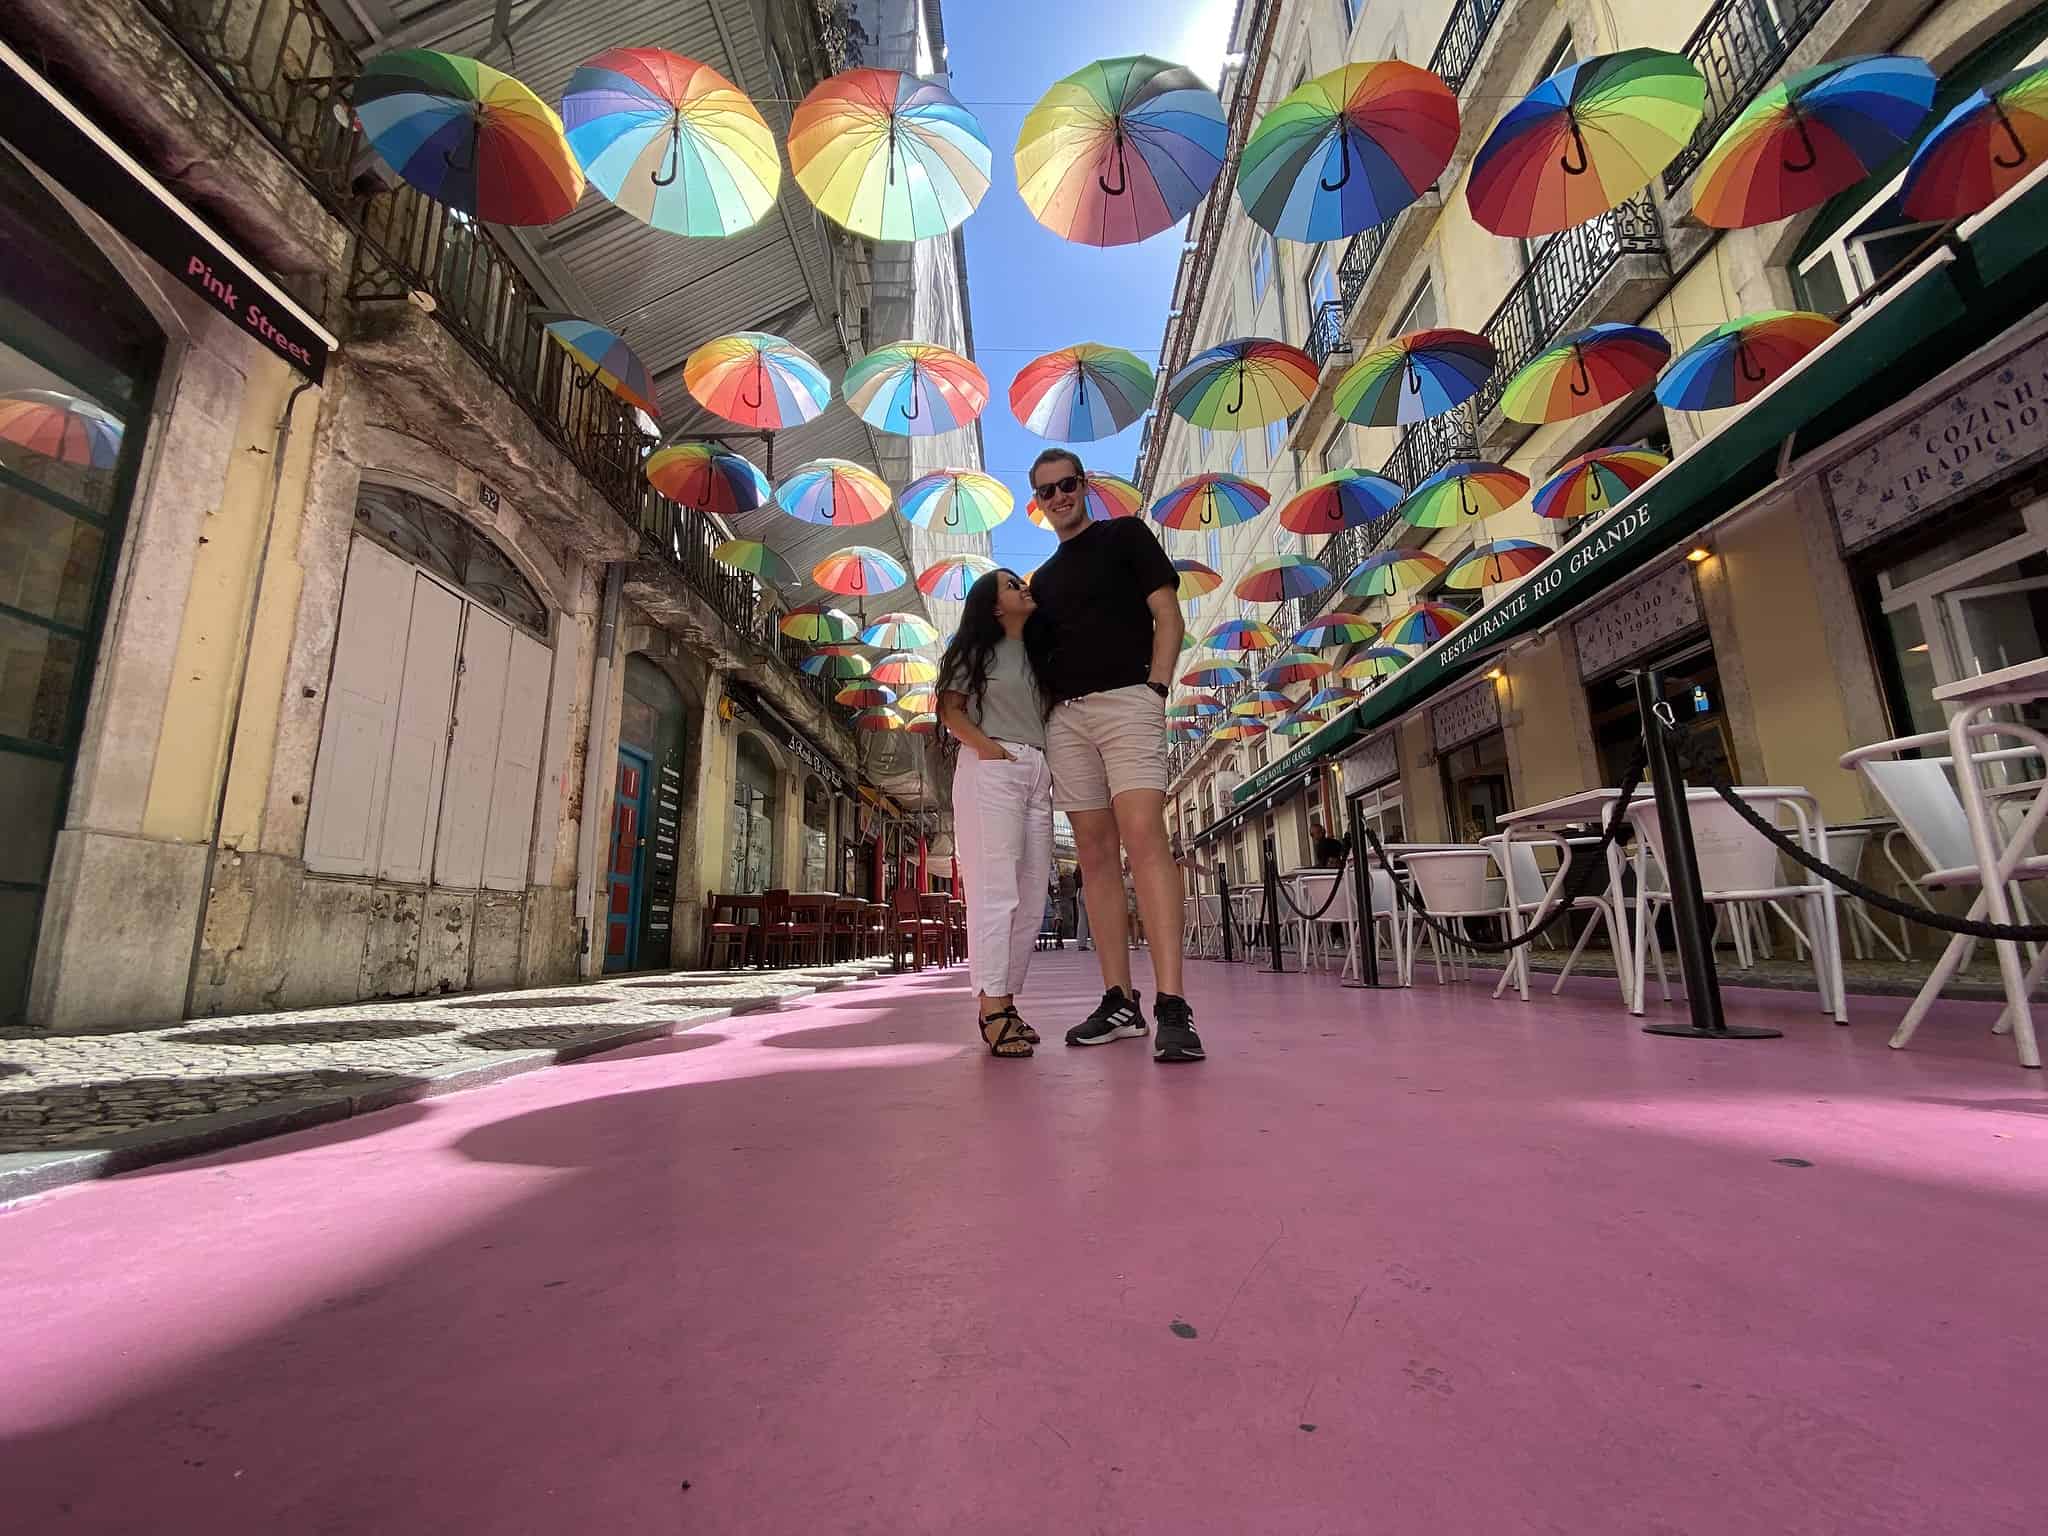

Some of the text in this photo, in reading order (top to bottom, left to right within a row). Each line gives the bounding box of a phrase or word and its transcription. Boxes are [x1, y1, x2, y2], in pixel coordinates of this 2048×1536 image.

[188, 255, 311, 366] Pink Street
[484, 486, 497, 509] 52
[1440, 503, 1650, 666] RESTAURANTE RIO GRANDE
